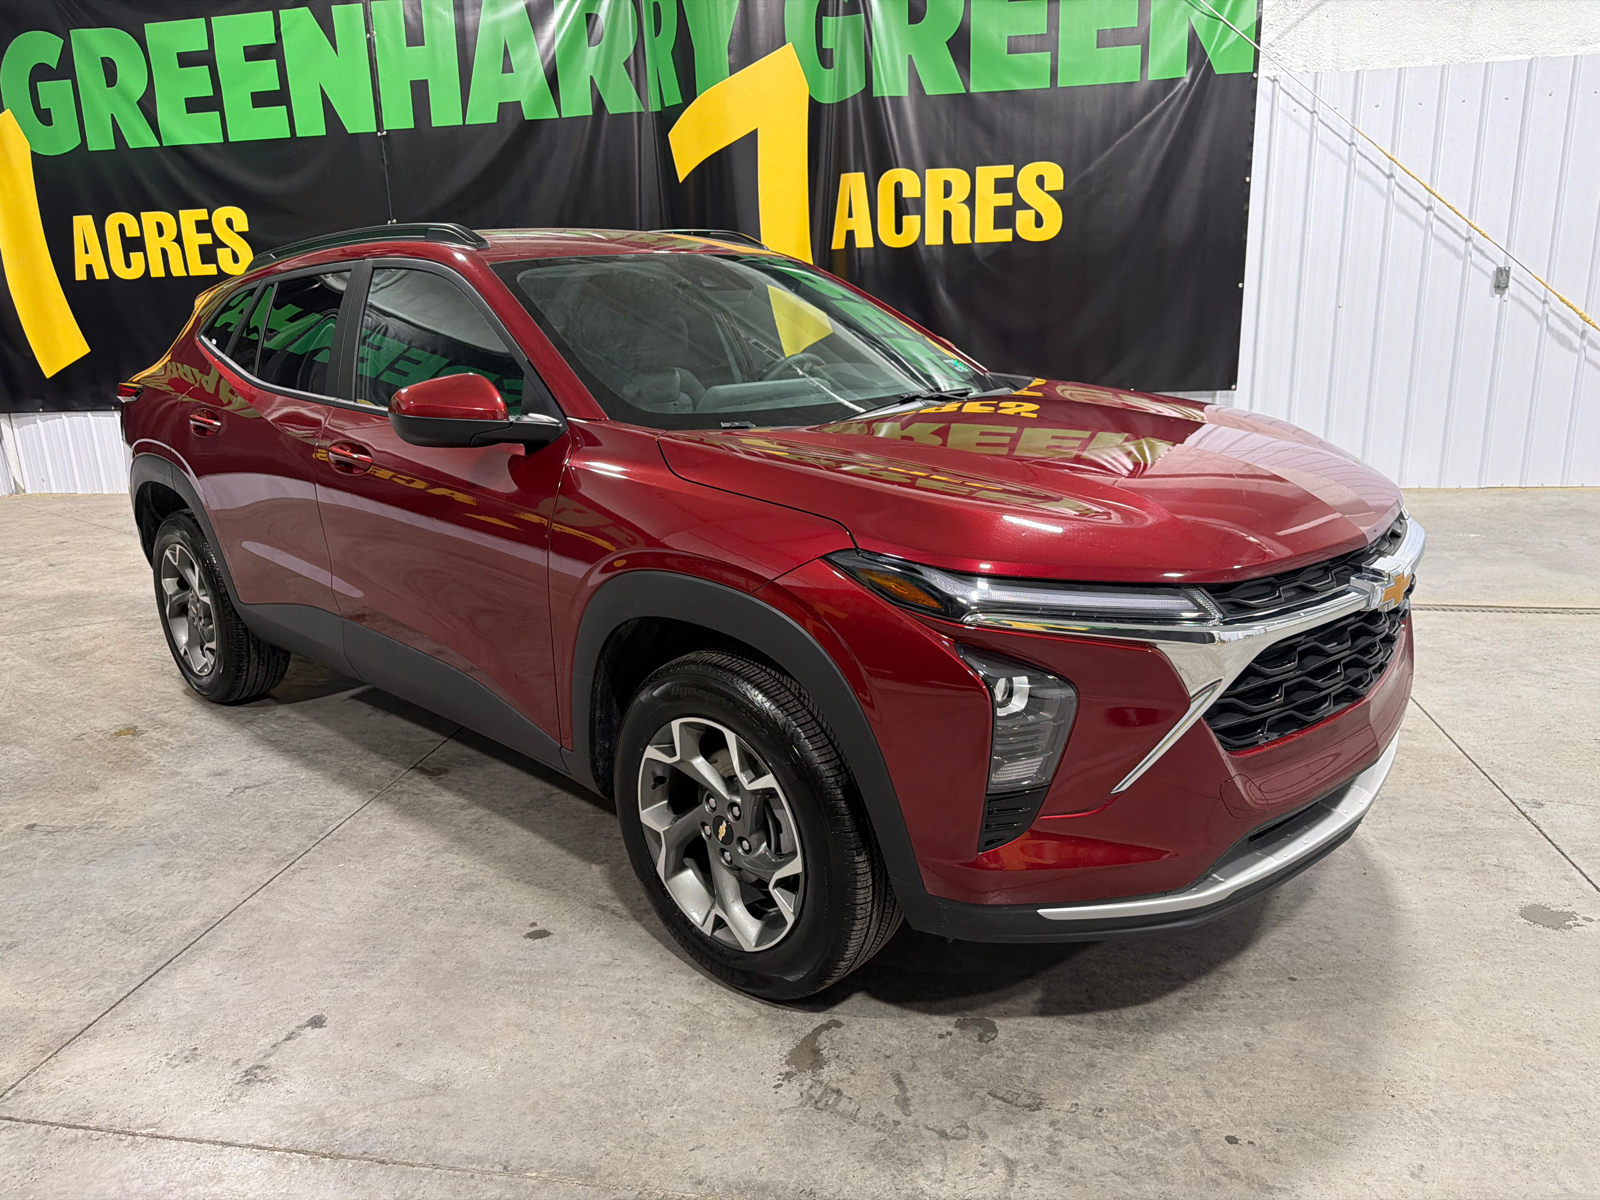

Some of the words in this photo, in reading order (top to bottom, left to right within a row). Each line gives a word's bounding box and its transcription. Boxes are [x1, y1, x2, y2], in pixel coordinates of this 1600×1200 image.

[0, 3, 377, 156] GREEN
[370, 0, 740, 130] HARRY
[784, 0, 1257, 104] GREEN
[667, 41, 814, 265] 7
[831, 161, 1064, 250] ACRES
[73, 206, 254, 281] ACRES
